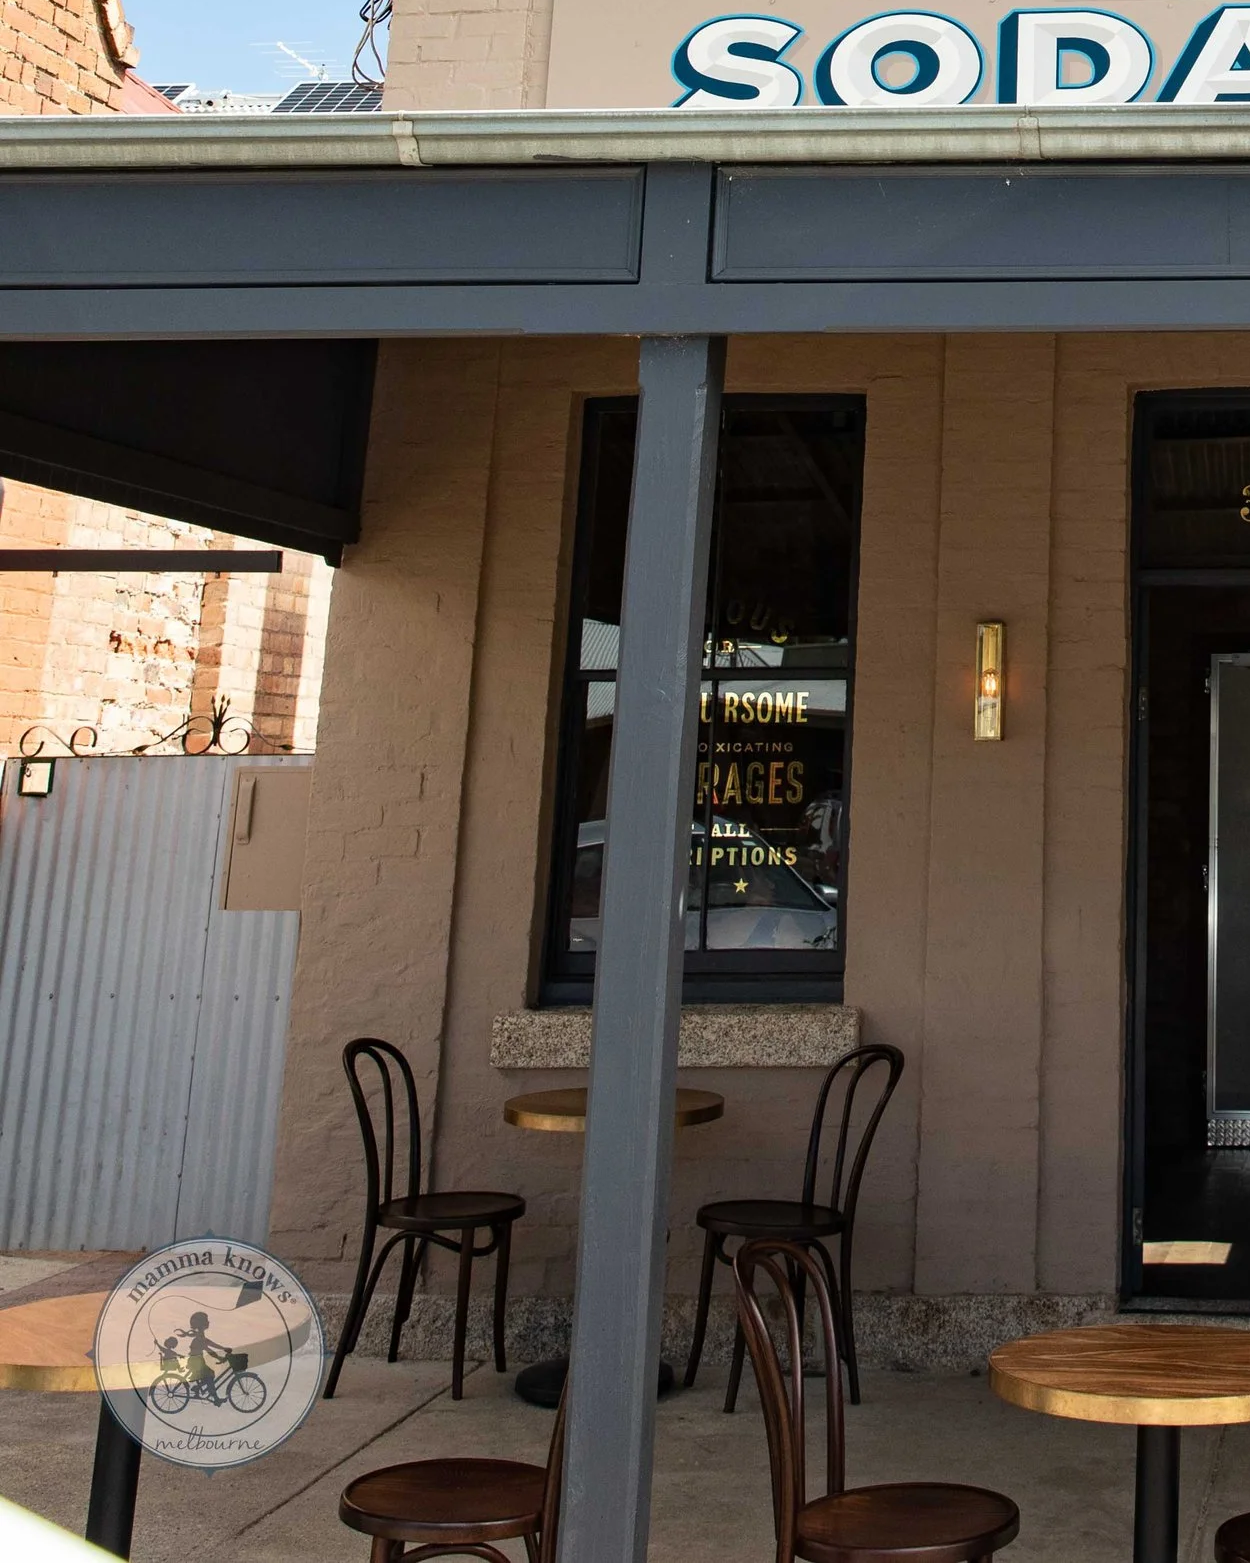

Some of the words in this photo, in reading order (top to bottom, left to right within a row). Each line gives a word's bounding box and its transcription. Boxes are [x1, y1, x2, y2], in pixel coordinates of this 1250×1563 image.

[725, 598, 796, 644] OUS
[704, 640, 735, 654] OR
[700, 691, 810, 724] URSOME
[698, 741, 794, 753] OXICATING
[697, 761, 806, 805] RAGES
[711, 823, 751, 838] ALL
[689, 846, 798, 866] IPTIONS
